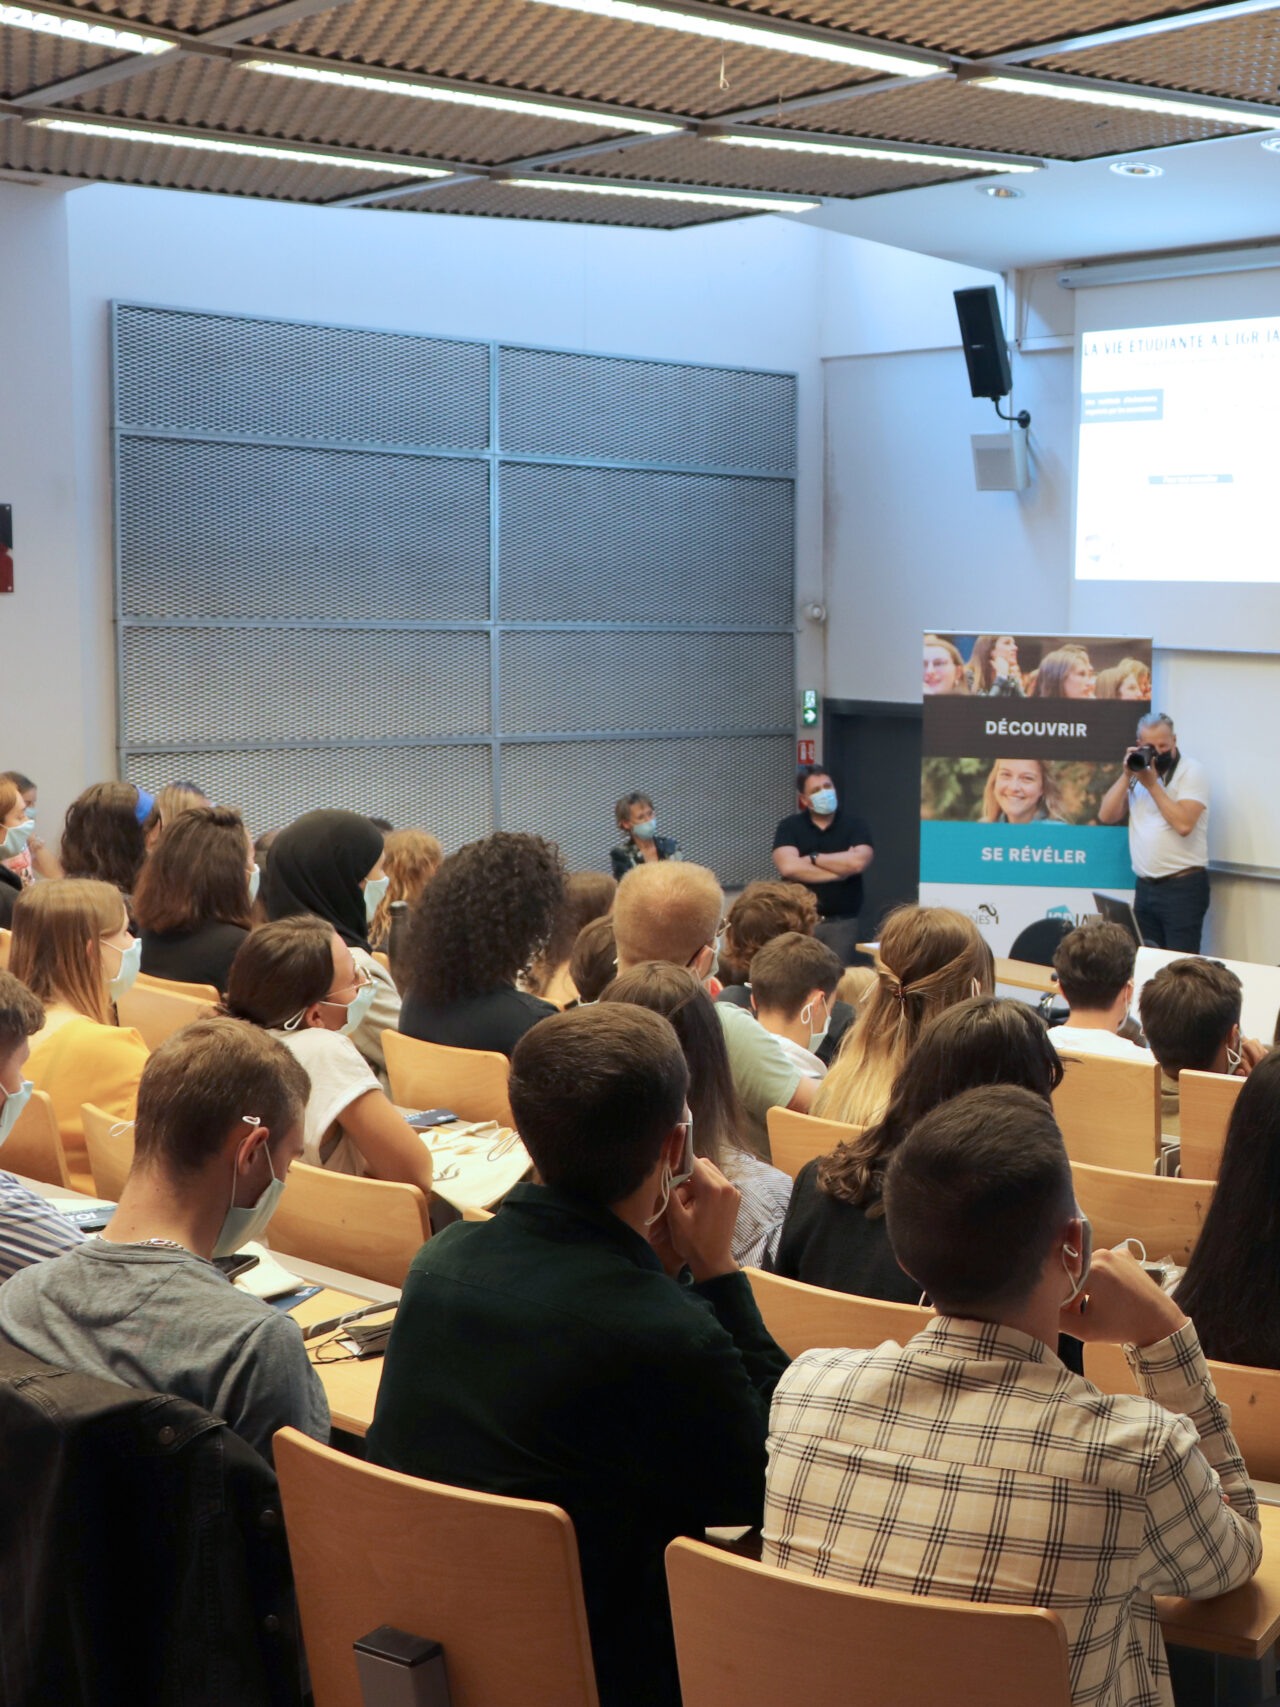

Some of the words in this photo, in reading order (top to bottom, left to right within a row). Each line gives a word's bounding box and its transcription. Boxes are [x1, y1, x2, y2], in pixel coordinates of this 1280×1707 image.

[1083, 343, 1098, 356] LA
[1104, 340, 1123, 355] VIE
[1129, 335, 1204, 353] ETUDIANTE
[985, 717, 1088, 738] DÉCOUVRIR
[981, 846, 1004, 862] SE
[1008, 845, 1087, 865] RÉVÉLER
